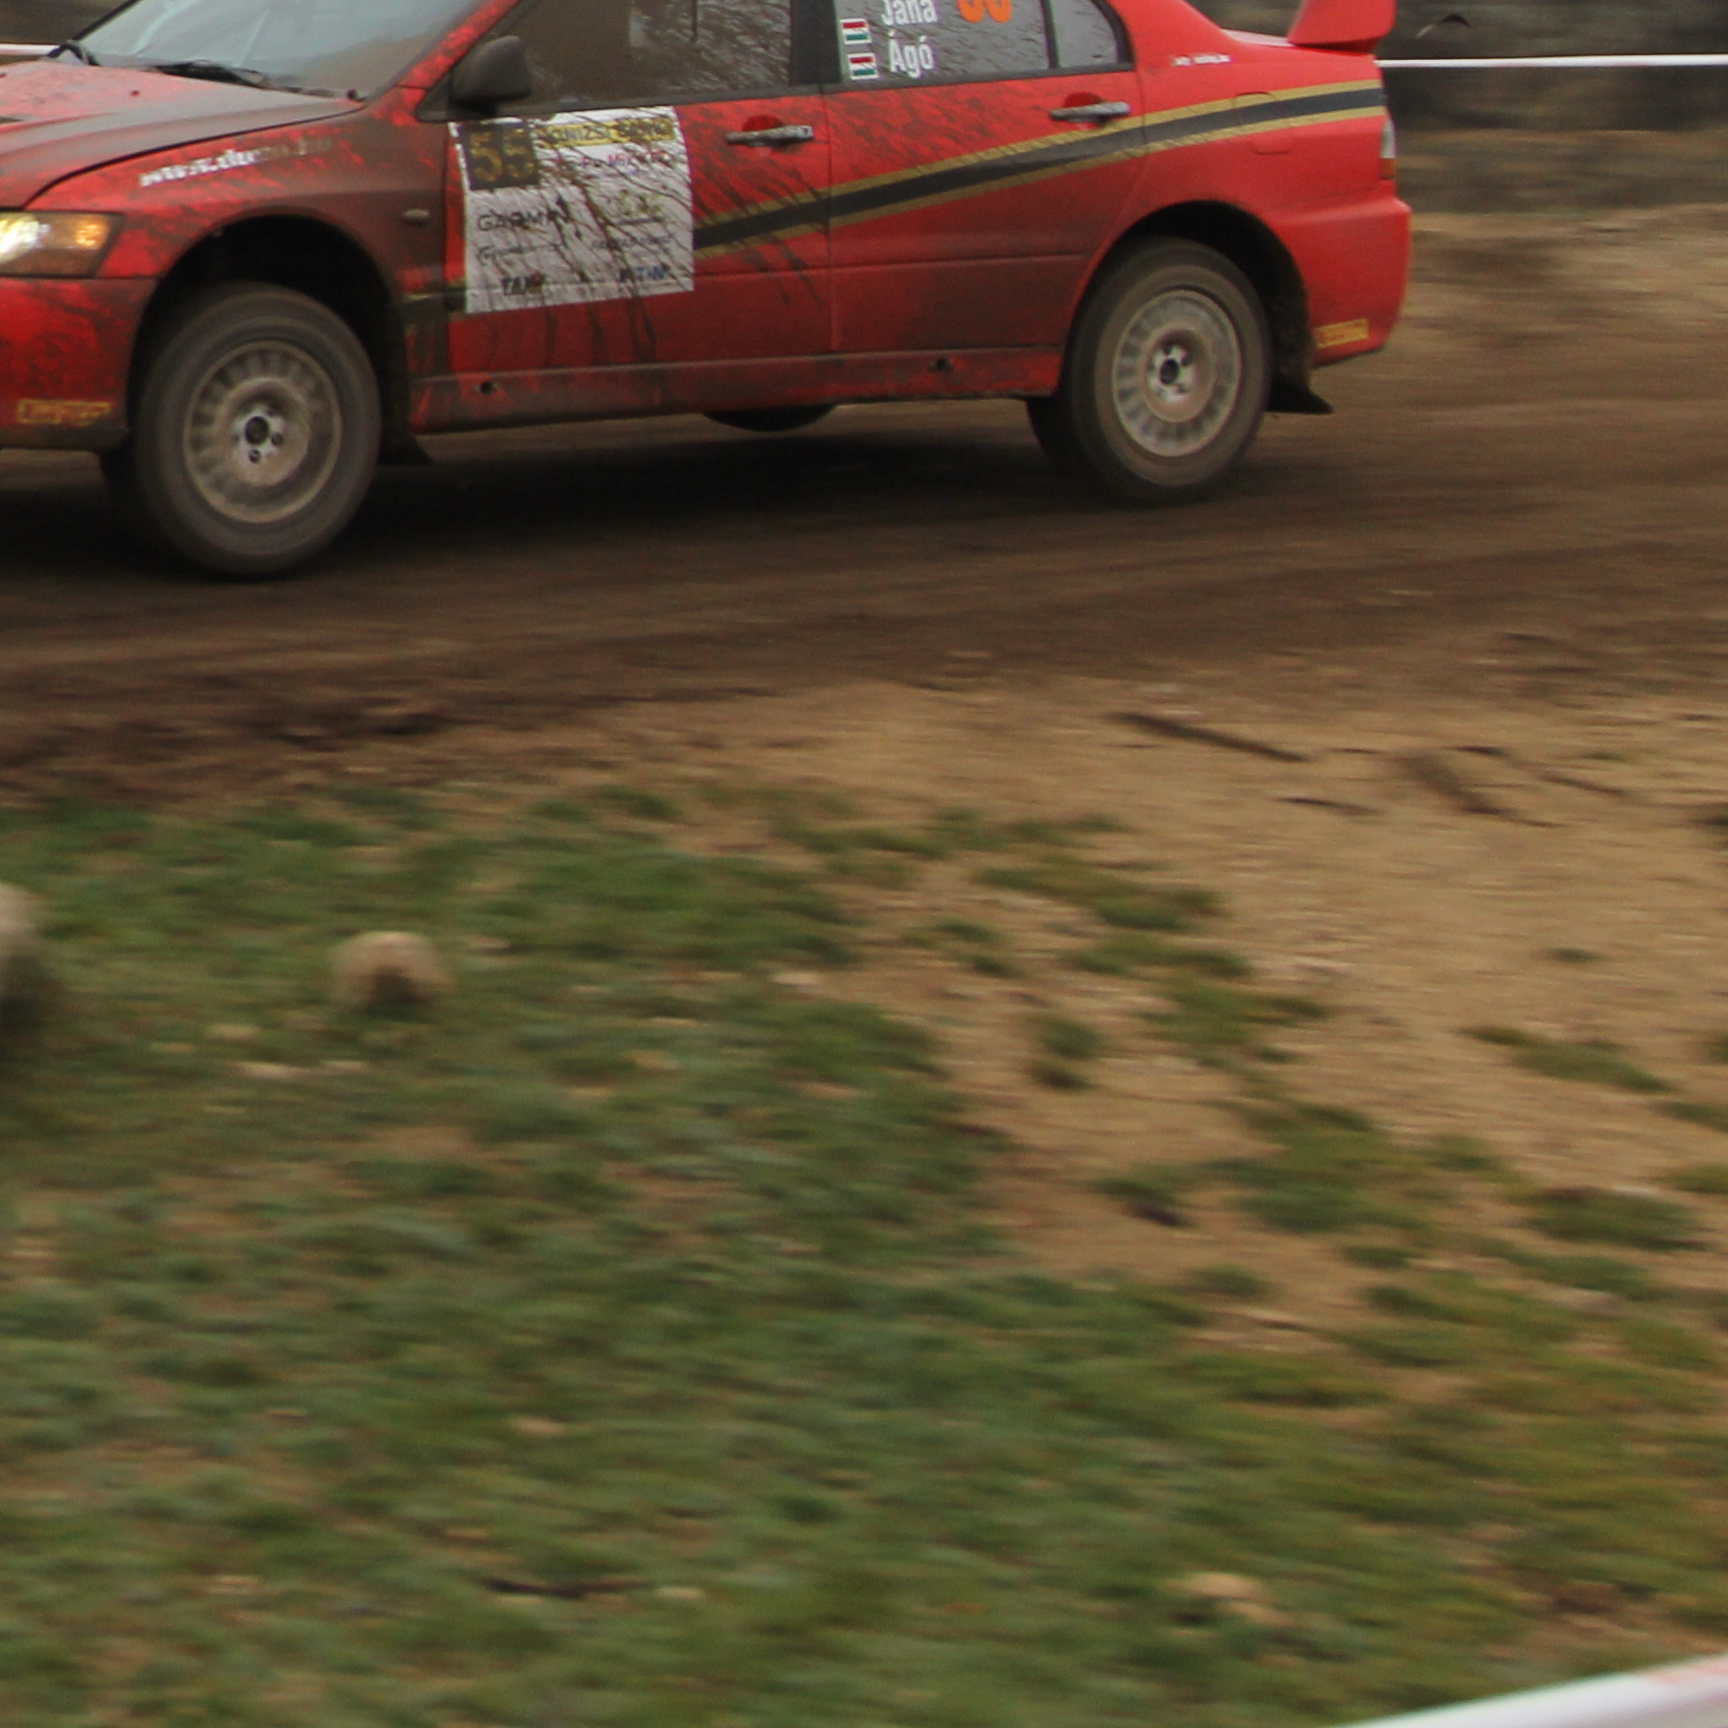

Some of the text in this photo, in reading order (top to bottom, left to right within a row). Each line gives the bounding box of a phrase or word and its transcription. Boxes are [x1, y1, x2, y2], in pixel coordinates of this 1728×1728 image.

[888, 29, 935, 79] Ágó
[470, 127, 535, 182] 55
[478, 204, 567, 231] GARMI
